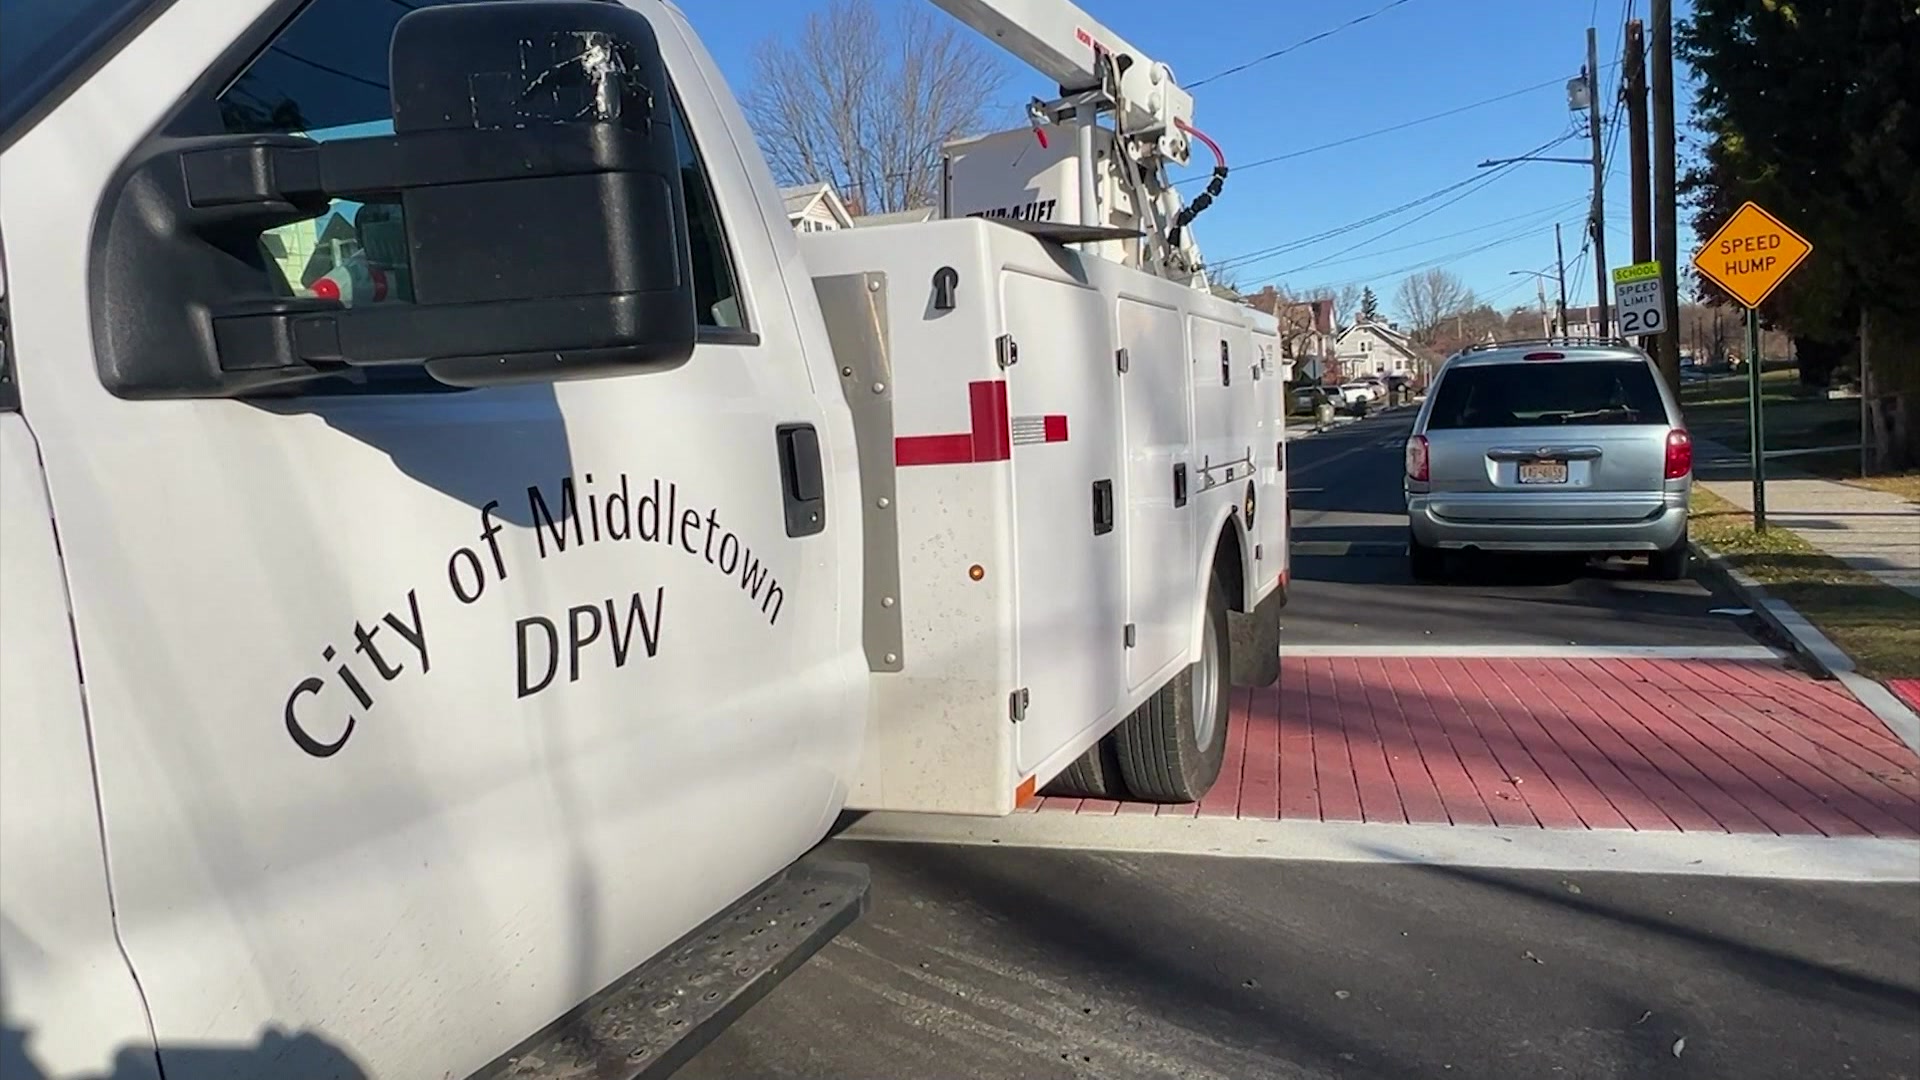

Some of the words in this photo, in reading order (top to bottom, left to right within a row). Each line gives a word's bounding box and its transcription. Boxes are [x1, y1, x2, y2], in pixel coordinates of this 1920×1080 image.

[1720, 233, 1781, 255] SPEED
[1615, 265, 1657, 280] SCHOOL
[1725, 255, 1777, 276] HUMP
[1618, 281, 1658, 297] SPEED
[1623, 294, 1654, 307] LIMIT
[1622, 308, 1660, 332] 20
[284, 587, 430, 759] City
[447, 499, 508, 604] of
[526, 472, 786, 626] Middletown
[514, 585, 666, 699] DPW
